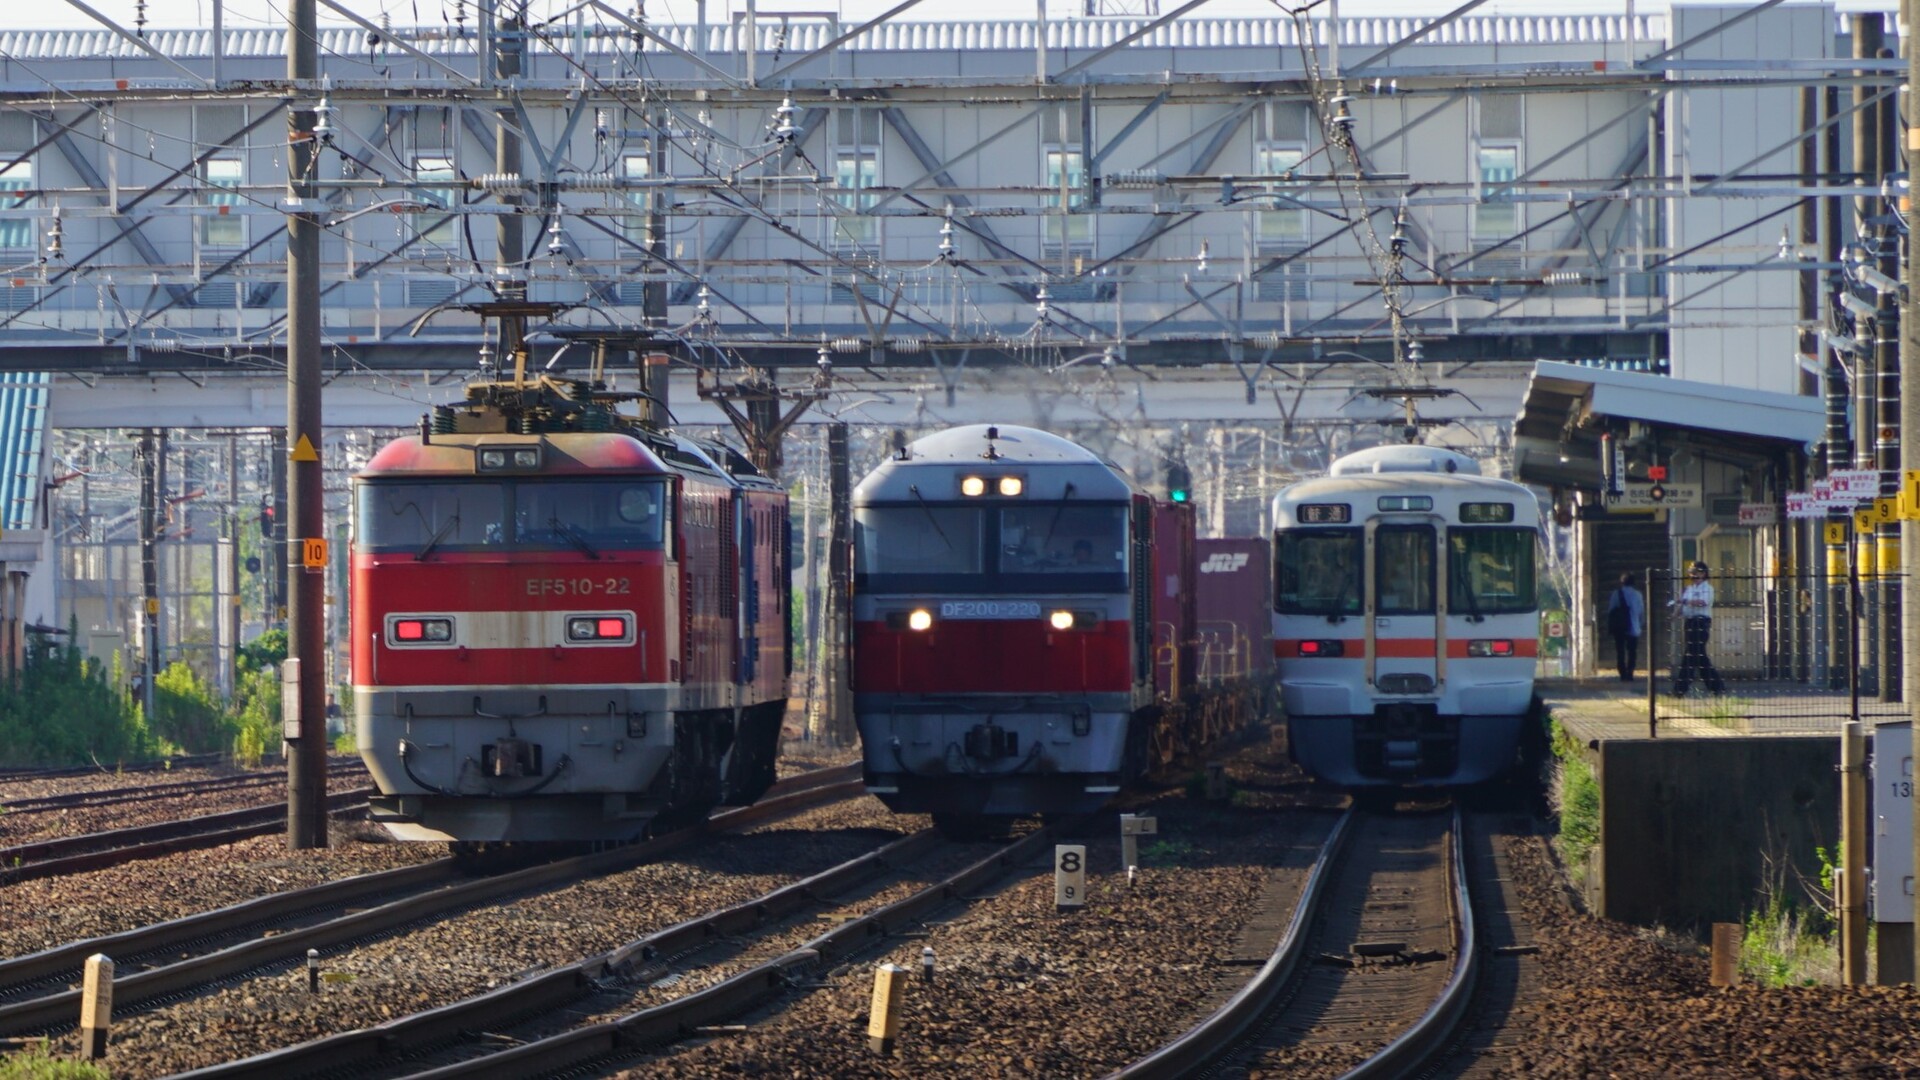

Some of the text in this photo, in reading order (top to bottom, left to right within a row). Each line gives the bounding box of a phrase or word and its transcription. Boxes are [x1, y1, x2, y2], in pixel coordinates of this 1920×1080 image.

[1881, 503, 1888, 517] 9
[309, 544, 322, 560] 10
[526, 578, 631, 596] EF510-22
[942, 602, 1041, 617] DF200-220
[1891, 781, 1914, 798] 13
[1060, 852, 1080, 873] 8
[1065, 886, 1075, 899] 9
